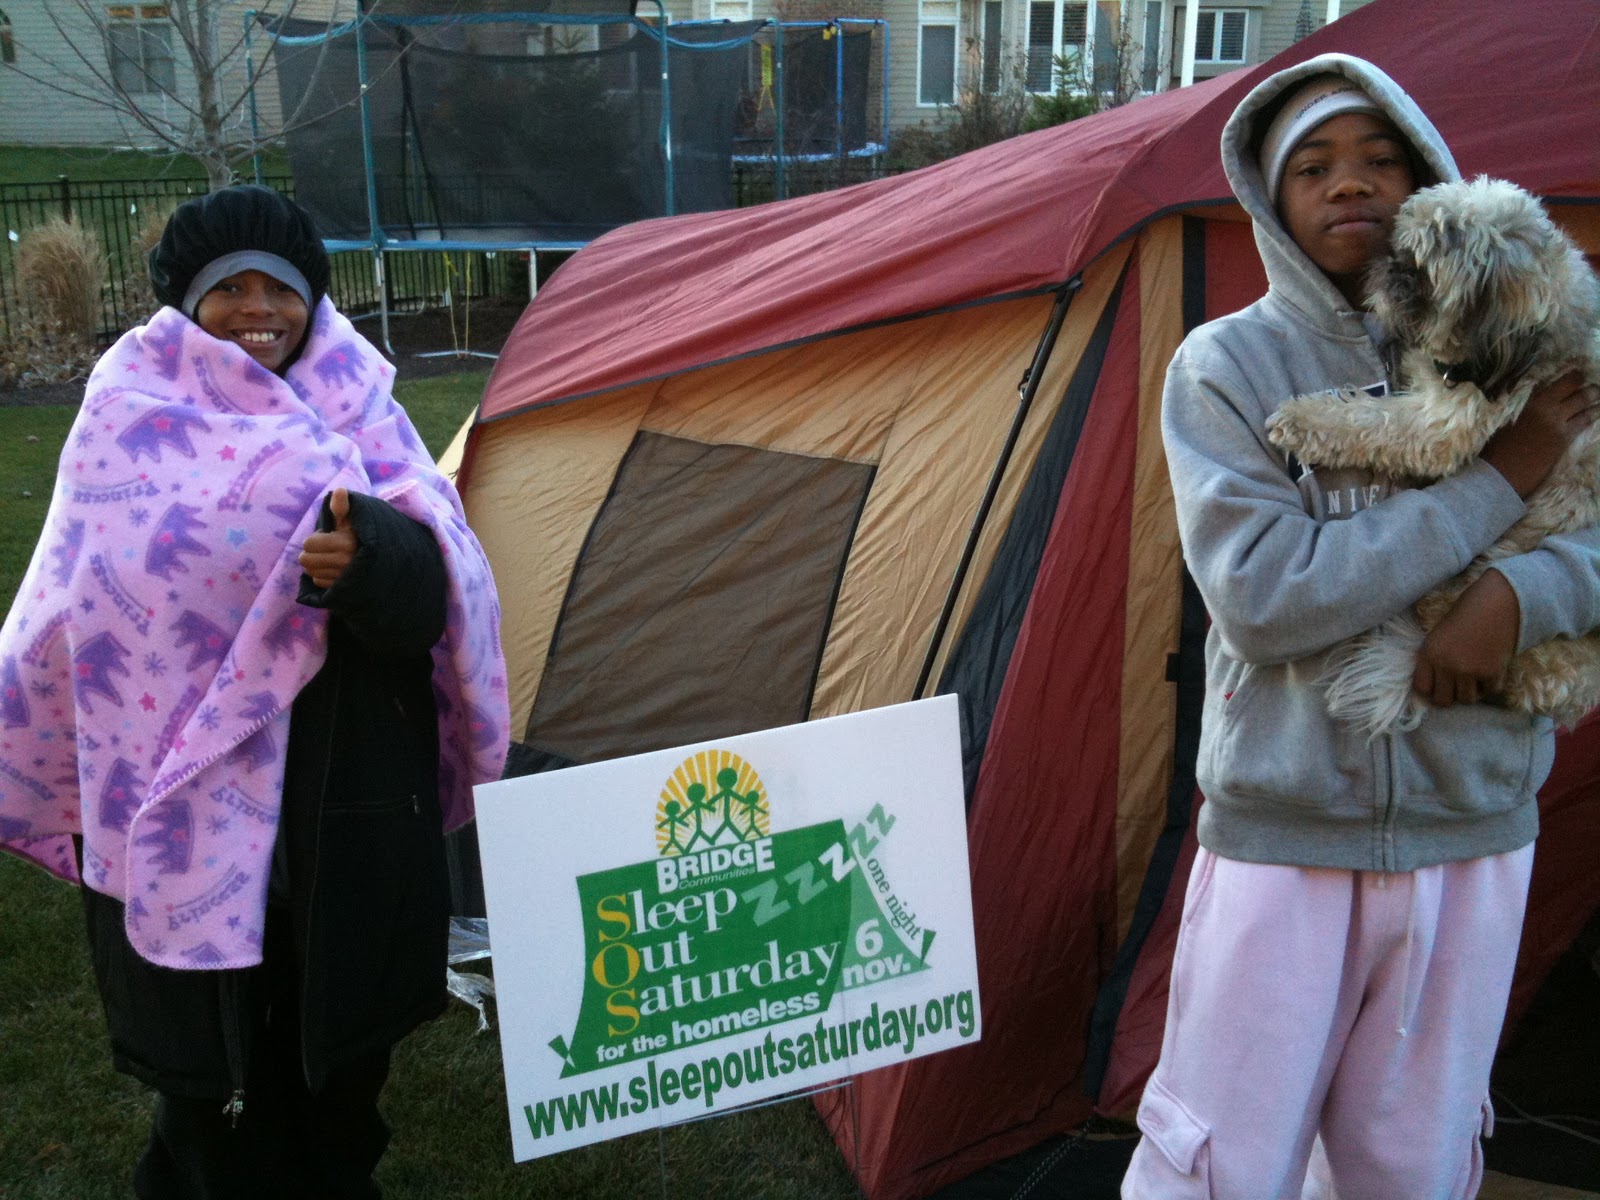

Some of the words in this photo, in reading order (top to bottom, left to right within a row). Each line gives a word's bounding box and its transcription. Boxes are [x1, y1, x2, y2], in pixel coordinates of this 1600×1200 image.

[656, 837, 776, 894] BRIDGE
[678, 866, 757, 890] Communities
[596, 886, 738, 942] Sleep
[866, 857, 891, 894] one
[885, 893, 922, 941] night
[593, 930, 699, 990] Out
[855, 918, 884, 958] 6
[605, 939, 842, 1038] Saturday
[842, 953, 911, 988] nov.
[596, 1040, 629, 1063] for
[632, 1031, 668, 1054] the
[671, 990, 821, 1046] homeless
[523, 989, 976, 1140] www.sleepoutsaturday.org
